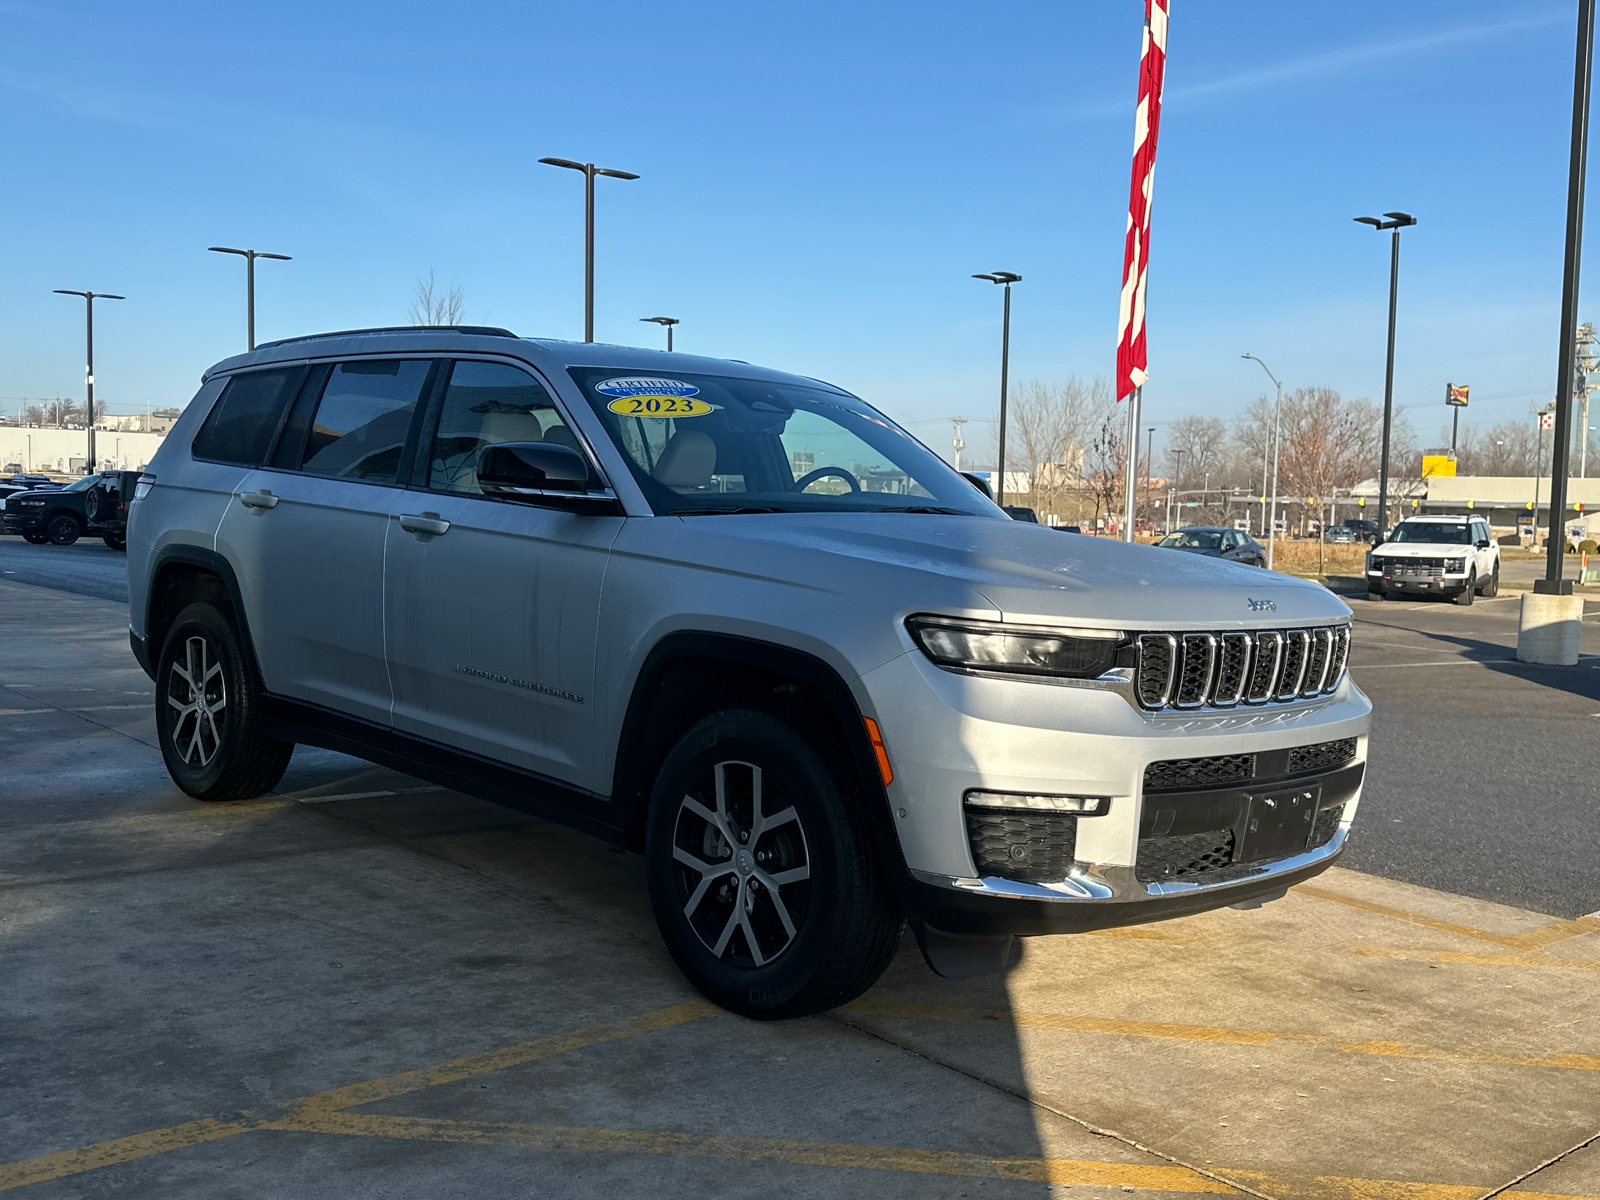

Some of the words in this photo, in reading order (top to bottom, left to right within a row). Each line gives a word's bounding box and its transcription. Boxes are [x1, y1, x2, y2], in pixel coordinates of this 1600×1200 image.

[604, 380, 686, 388] CERTIFIED
[629, 399, 694, 413] 2023
[1247, 597, 1277, 613] Jeep
[462, 665, 508, 684] GRAND
[510, 678, 584, 704] CHEROKEE
